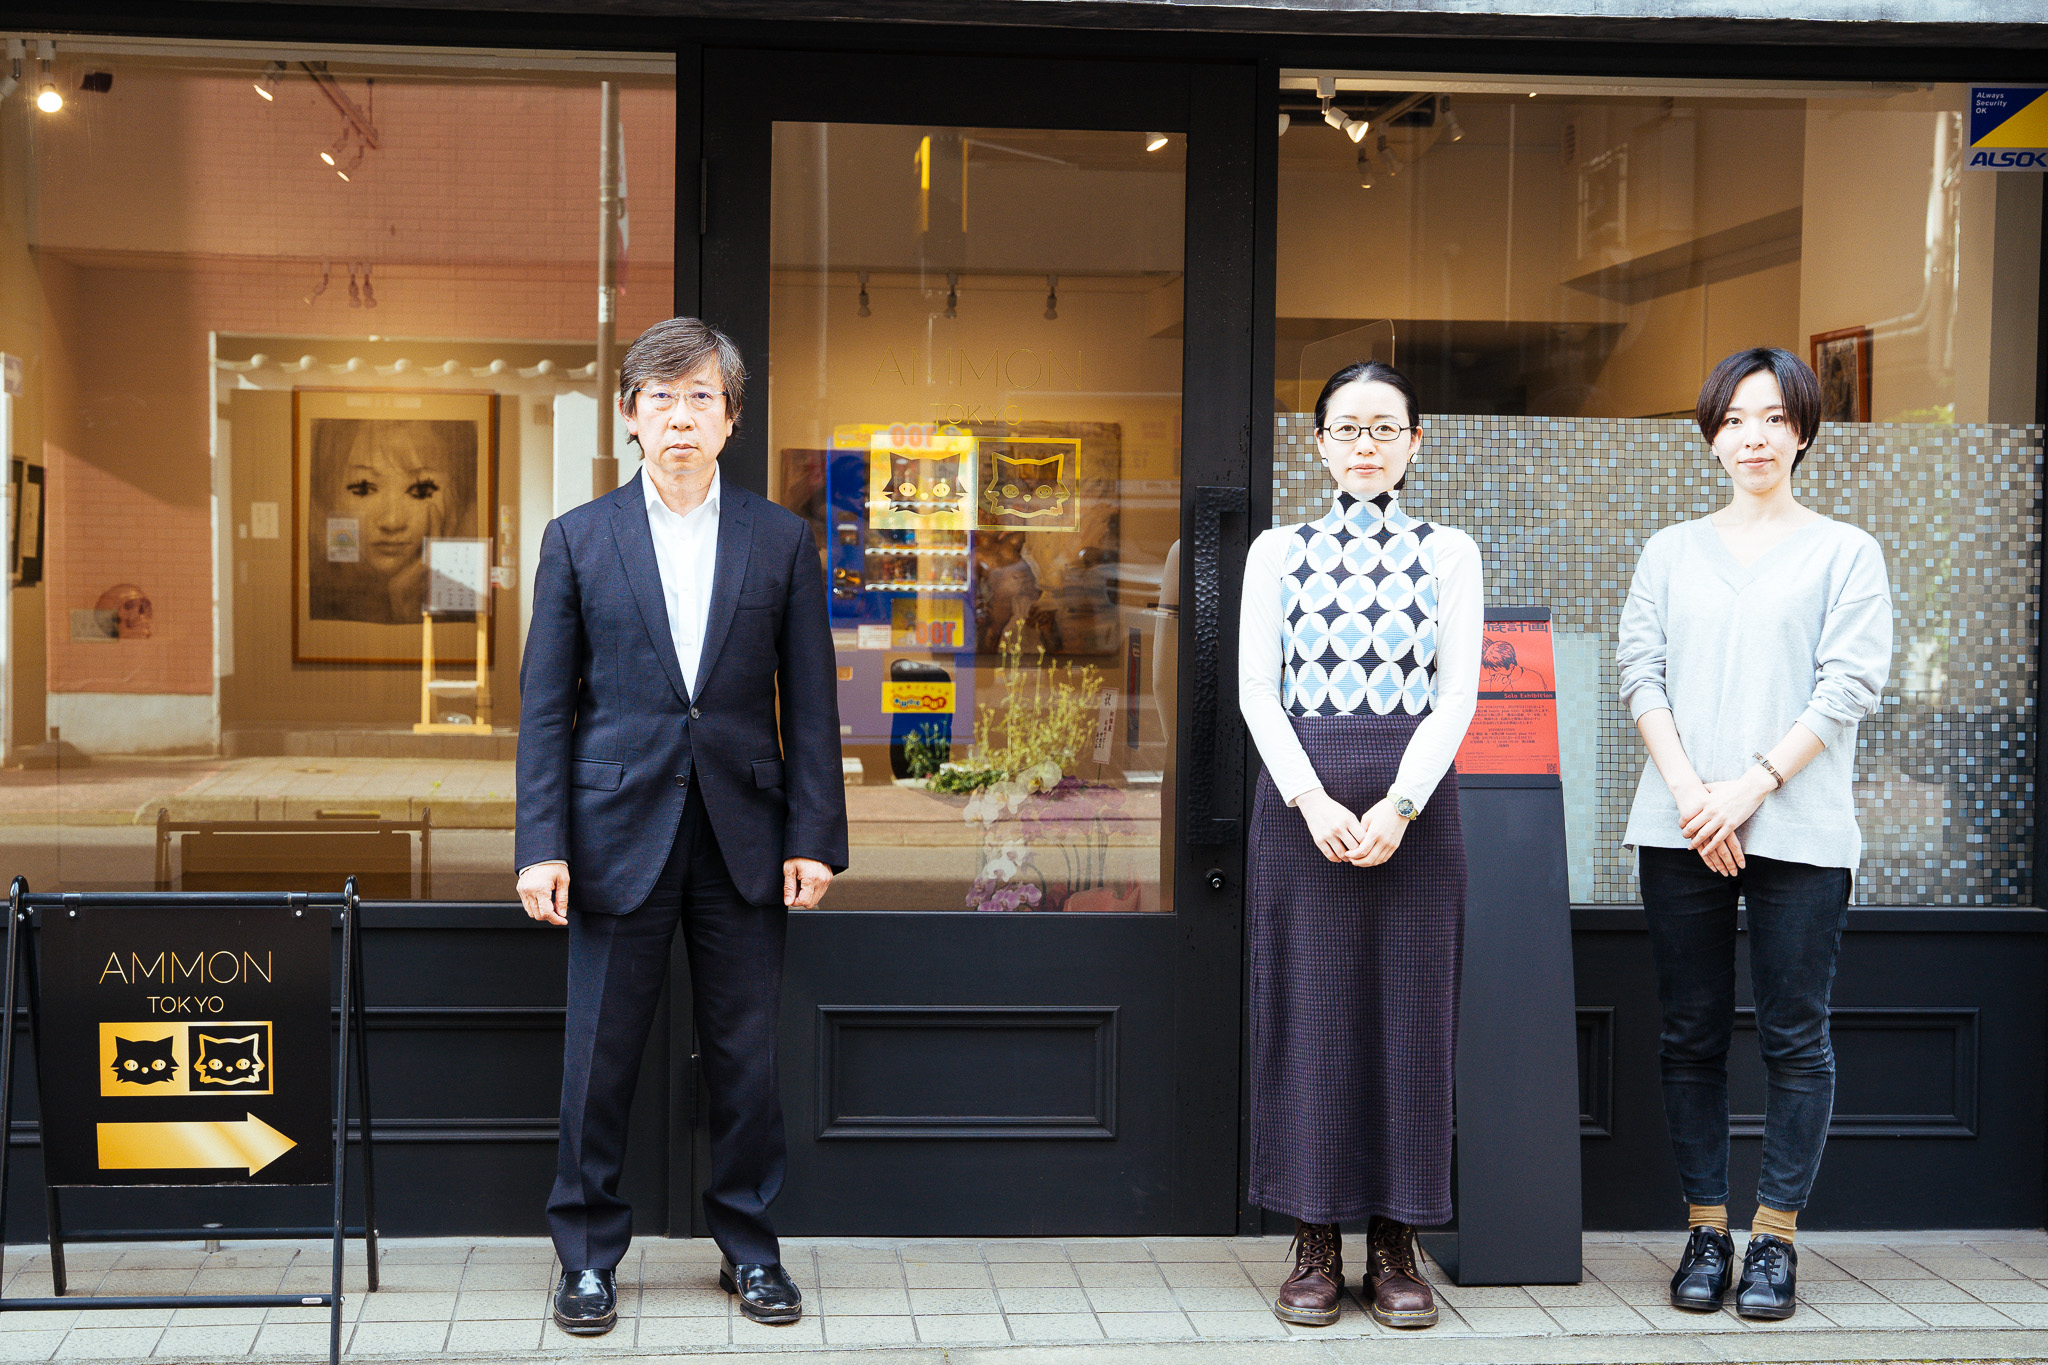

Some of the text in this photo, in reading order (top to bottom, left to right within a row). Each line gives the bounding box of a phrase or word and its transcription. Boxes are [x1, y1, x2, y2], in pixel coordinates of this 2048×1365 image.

[1970, 151, 2047, 167] ALSOK
[872, 346, 1082, 389] AMMON
[930, 402, 1023, 426] TOKYO
[1483, 621, 1548, 633] 族計画
[99, 951, 273, 985] AMMON
[147, 996, 224, 1013] TOKYO
